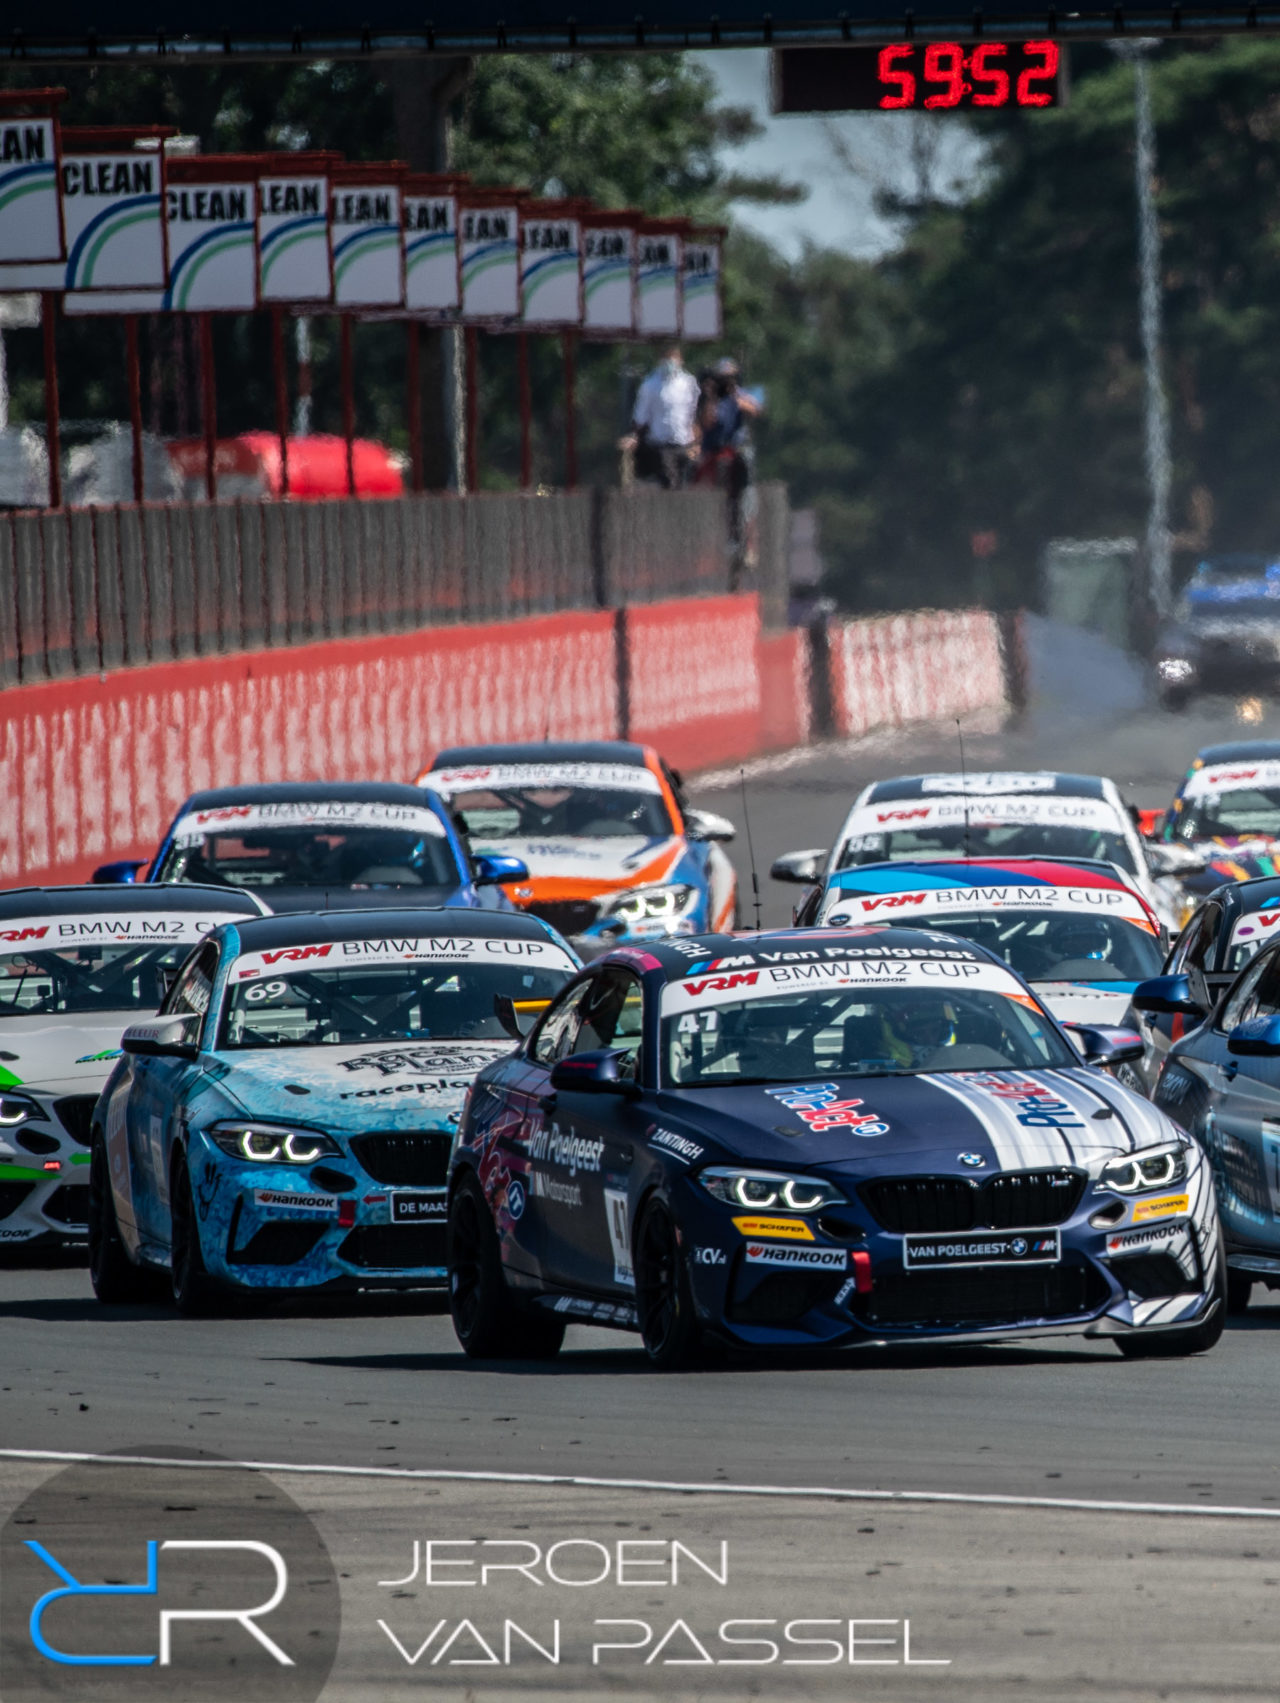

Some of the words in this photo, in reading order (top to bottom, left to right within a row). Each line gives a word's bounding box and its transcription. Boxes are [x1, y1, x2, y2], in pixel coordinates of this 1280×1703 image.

[0, 126, 44, 162] AN
[64, 160, 152, 196] CLEAN
[168, 189, 247, 222] CLEAN
[258, 803, 320, 818] BMW
[327, 803, 362, 816] M2
[370, 803, 416, 820] CUP
[877, 807, 932, 823] VRM
[938, 804, 995, 816] BMW
[1006, 804, 1041, 816] M2
[861, 893, 927, 912] VRM
[936, 888, 1008, 903] BMW
[1017, 888, 1059, 902] M2
[1068, 889, 1123, 906] CUP
[0, 926, 50, 941] RM
[59, 921, 132, 936] BMW
[142, 921, 185, 934] M2
[261, 944, 334, 965] VRM
[343, 939, 419, 956] BMW
[430, 939, 475, 952] M2
[485, 940, 544, 956] CUP
[759, 949, 819, 962] Van
[824, 946, 977, 961] Poelgeest
[682, 971, 760, 997] VRM
[769, 962, 851, 982] BMW
[861, 961, 912, 975] M2
[919, 962, 981, 978] CUP
[244, 981, 288, 1002] 69
[677, 1009, 718, 1035] 47
[338, 1048, 463, 1072] Race
[373, 1050, 505, 1078] Plan
[527, 1118, 550, 1161] Van
[548, 1121, 605, 1177] Poelgeest
[652, 1127, 704, 1160] ZANTINGH
[399, 1203, 416, 1213] DE
[0, 1229, 31, 1239] OOK
[909, 1245, 935, 1258] VAN
[937, 1242, 1007, 1256] POELGEEST
